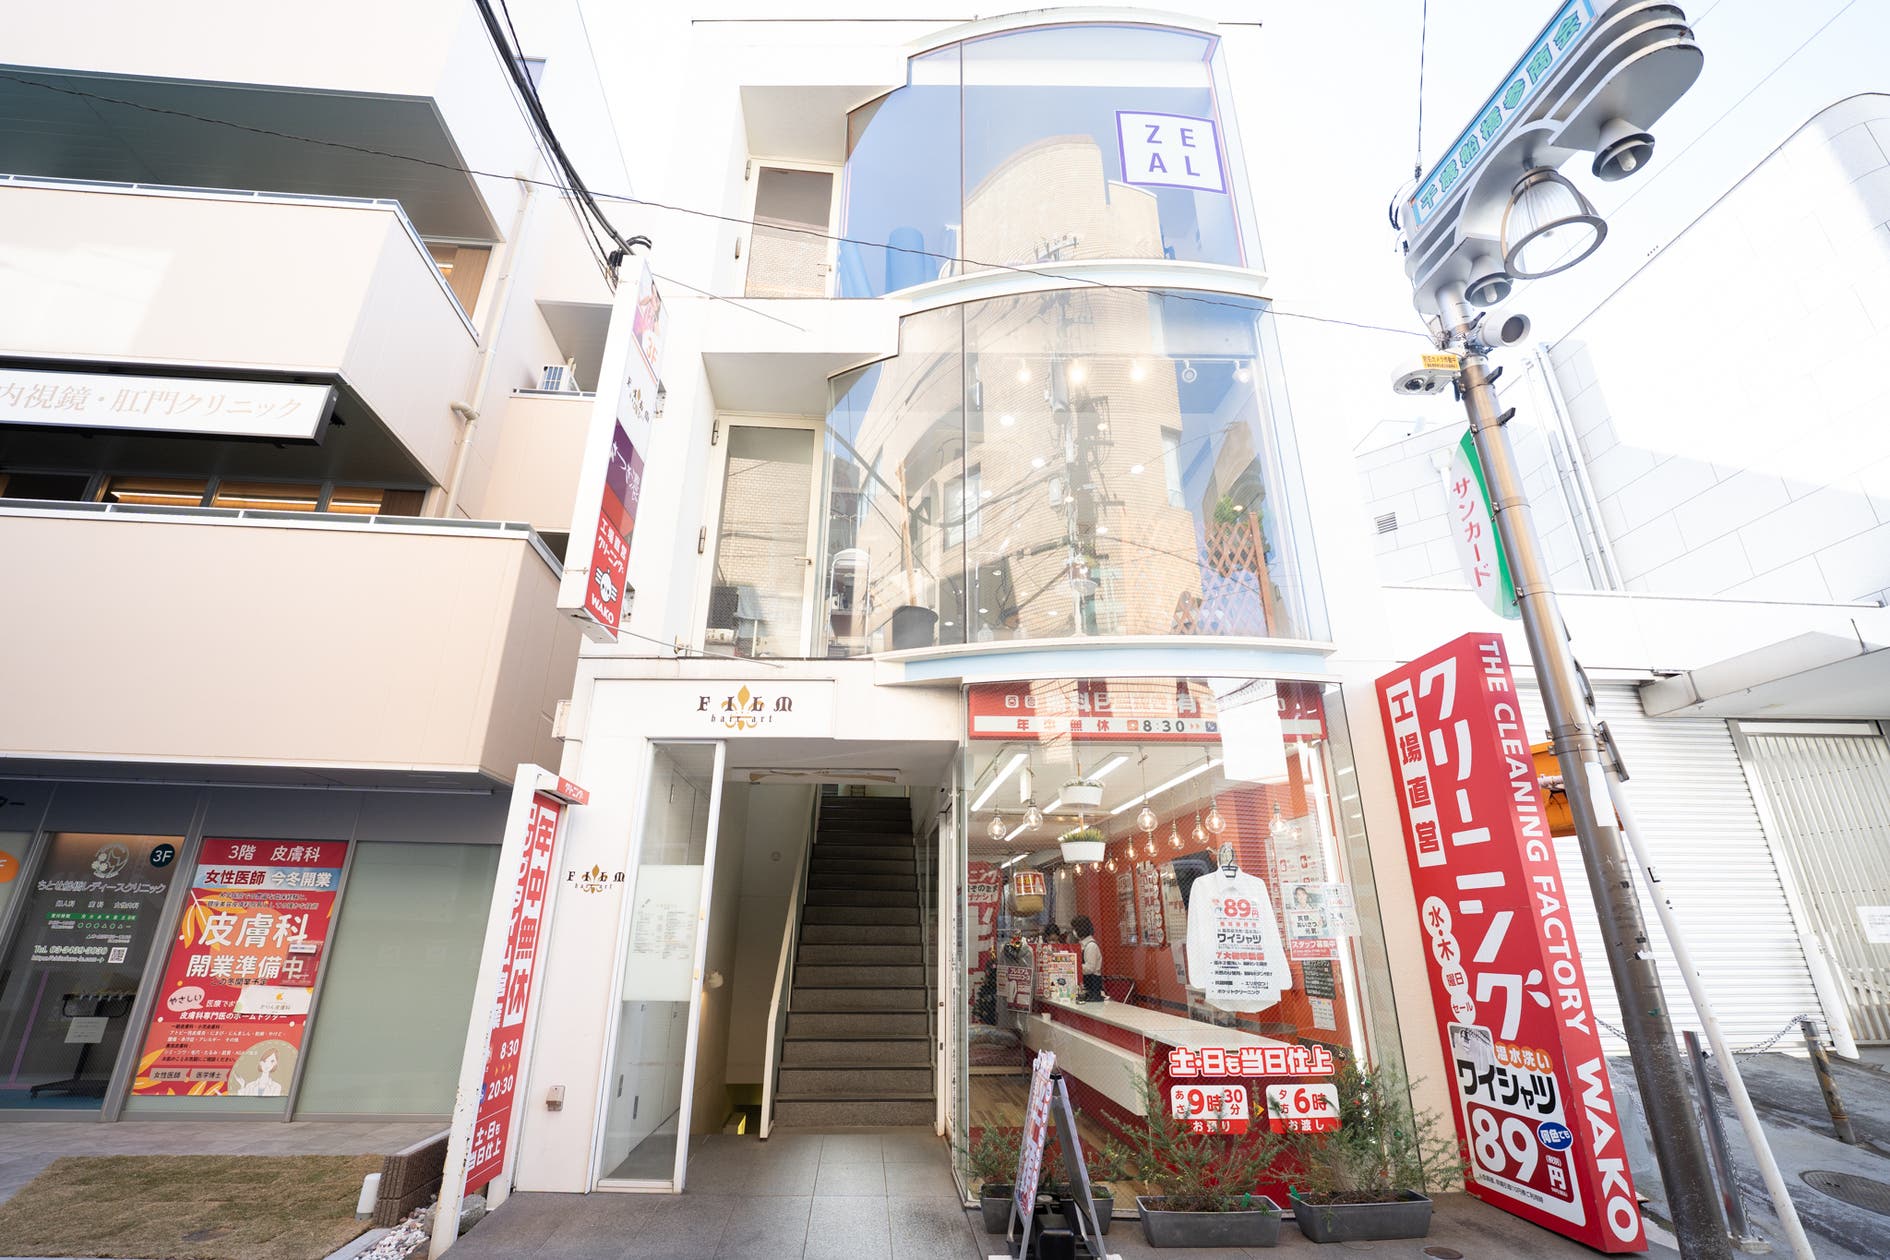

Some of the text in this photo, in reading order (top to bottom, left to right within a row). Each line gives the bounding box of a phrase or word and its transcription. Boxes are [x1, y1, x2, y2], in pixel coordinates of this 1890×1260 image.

[600, 517, 627, 561] 工場直営
[1452, 477, 1492, 588] サンカード
[598, 535, 624, 574] クリーニング
[591, 592, 615, 625] WAKO
[1391, 690, 1440, 854] 工場直営
[152, 850, 173, 863] 3F
[228, 845, 321, 863] 3階 皮膚科
[1418, 656, 1551, 1041] クリーニング
[204, 869, 332, 888] 女性医師 今冬開業
[1223, 898, 1251, 918] 89
[199, 911, 311, 949] 皮膚科
[1217, 933, 1262, 945] ワイシャツ
[1478, 640, 1639, 1243] THE CLEANING FACTORY WAKO
[186, 955, 304, 979] 開業準備中
[169, 992, 202, 1006] やさしい
[1495, 1044, 1550, 1070] 温水洗い
[153, 1071, 182, 1080] 女性医師
[1457, 1059, 1556, 1114] ワイシャツ
[1288, 1119, 1325, 1131] お渡し
[1472, 1108, 1539, 1183] 89
[1547, 1164, 1566, 1190] 円
